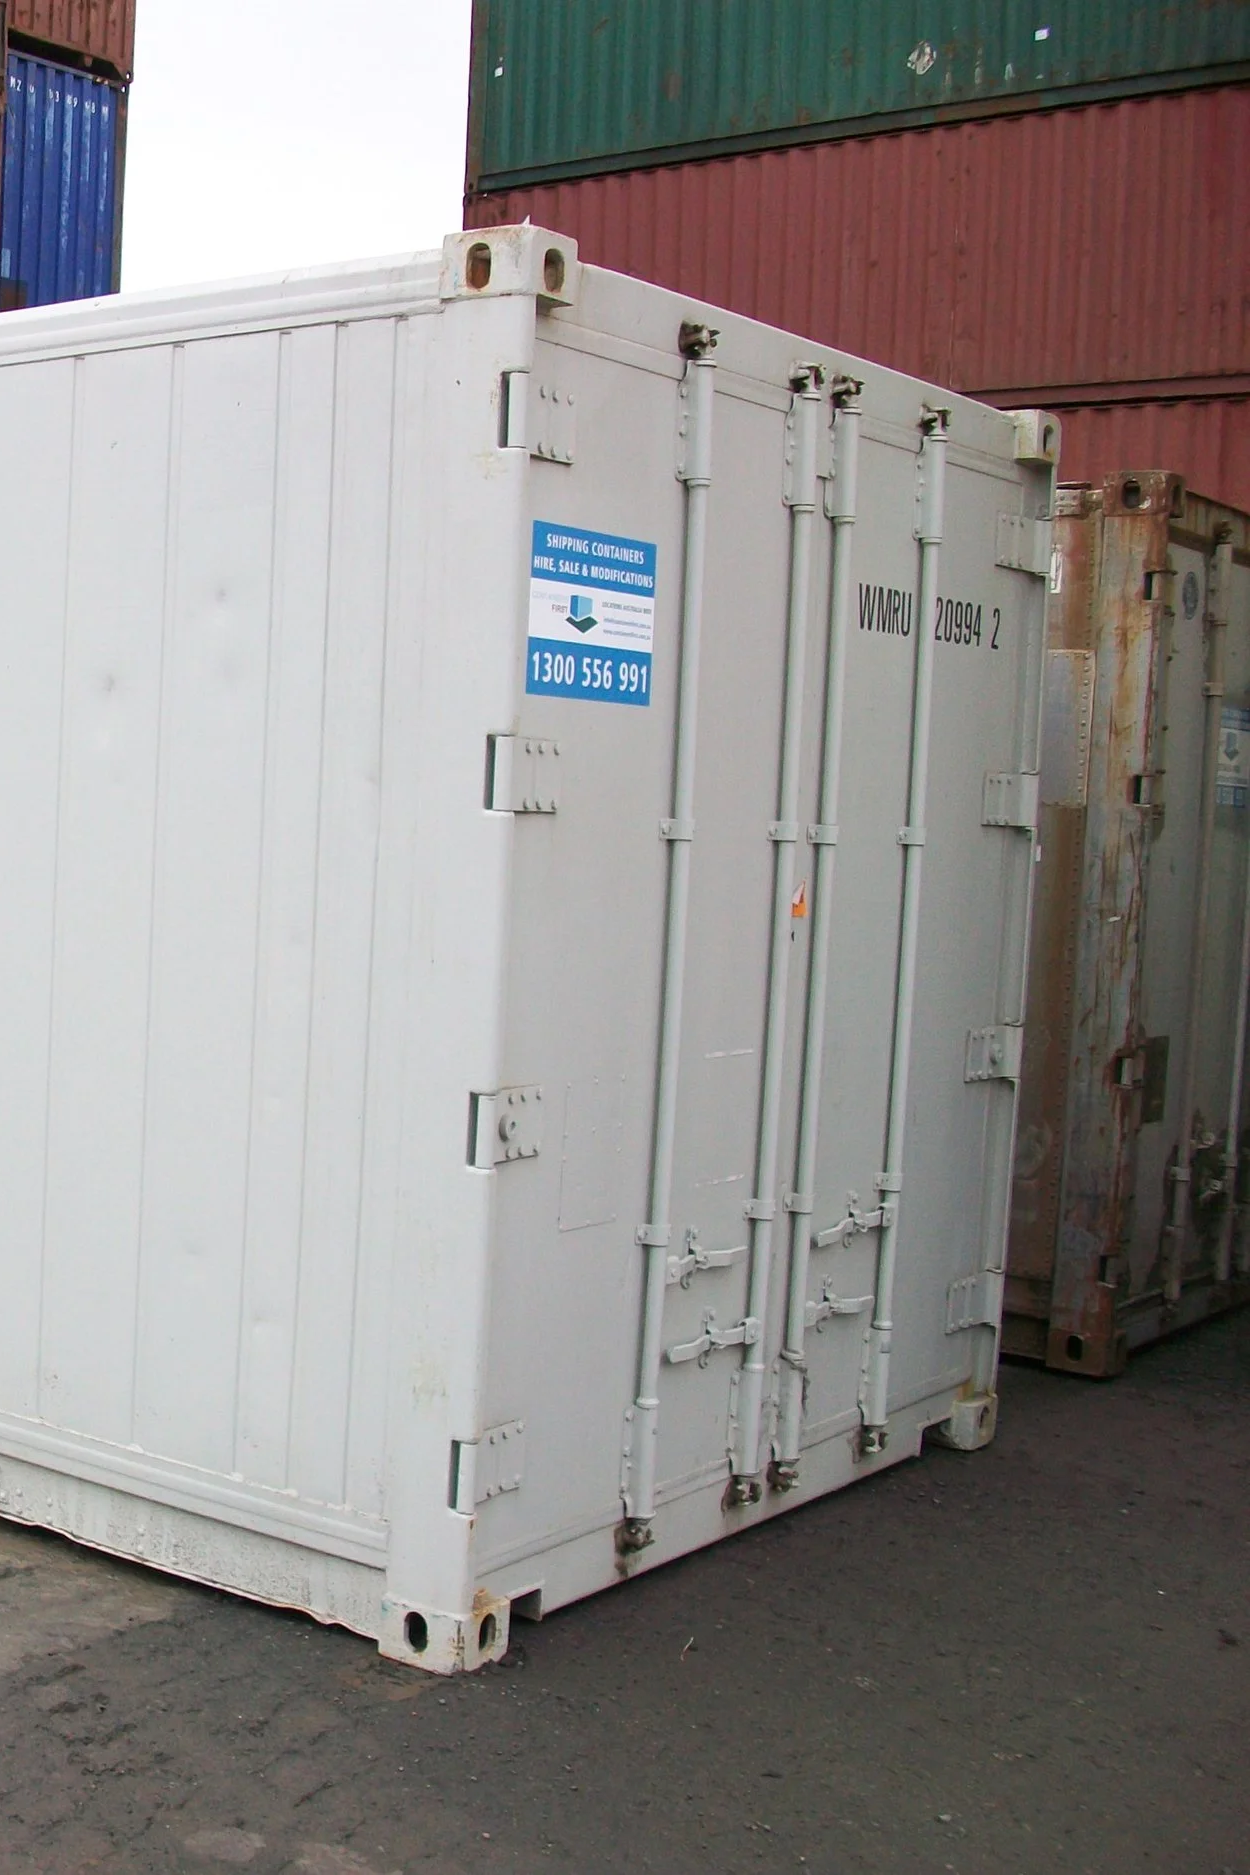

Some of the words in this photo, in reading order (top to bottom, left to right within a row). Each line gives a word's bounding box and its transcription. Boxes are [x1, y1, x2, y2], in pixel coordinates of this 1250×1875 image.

[546, 533, 589, 554] SHIPPING
[591, 542, 644, 565] CONTAINERS
[533, 555, 557, 573] HIRE,
[559, 560, 580, 576] SALE
[582, 564, 588, 577] &
[590, 565, 654, 589] MODIFICATIONS
[859, 583, 912, 636] WMRU
[990, 608, 1000, 650] 2
[532, 651, 575, 685] 1300
[581, 657, 613, 690] 556
[618, 662, 648, 694] 991
